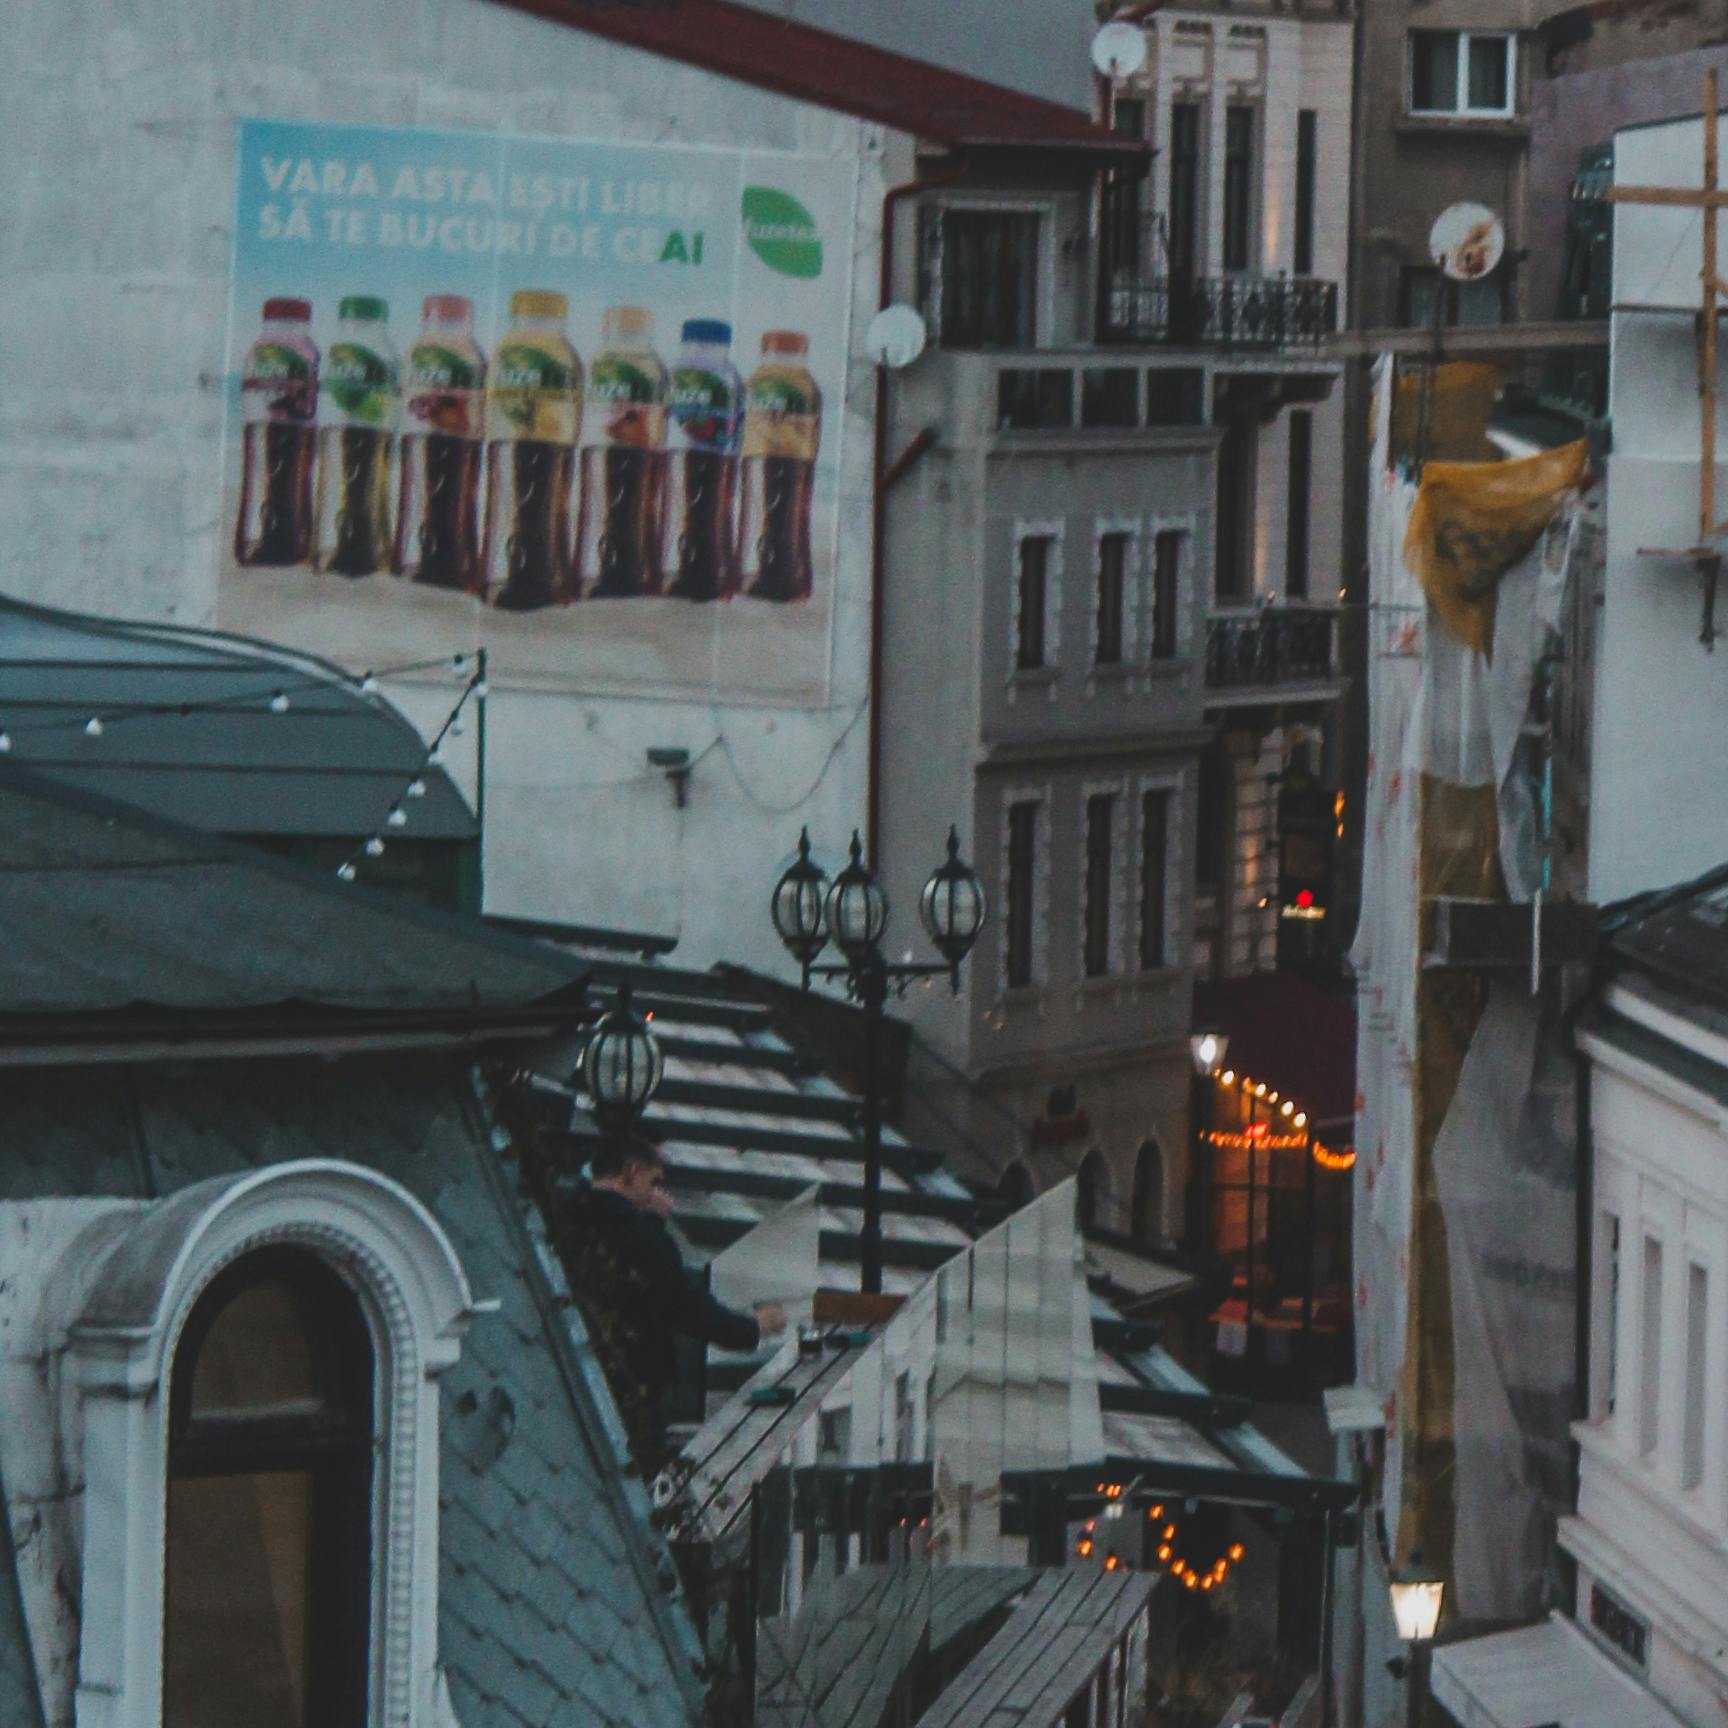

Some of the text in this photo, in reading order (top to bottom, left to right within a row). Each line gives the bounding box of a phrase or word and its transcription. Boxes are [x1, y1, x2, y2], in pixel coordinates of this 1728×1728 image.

[260, 156, 709, 219] VARA ASTA EȘTI LIBER
[259, 197, 703, 266] SĂ TE BUCURI DE CEAI
